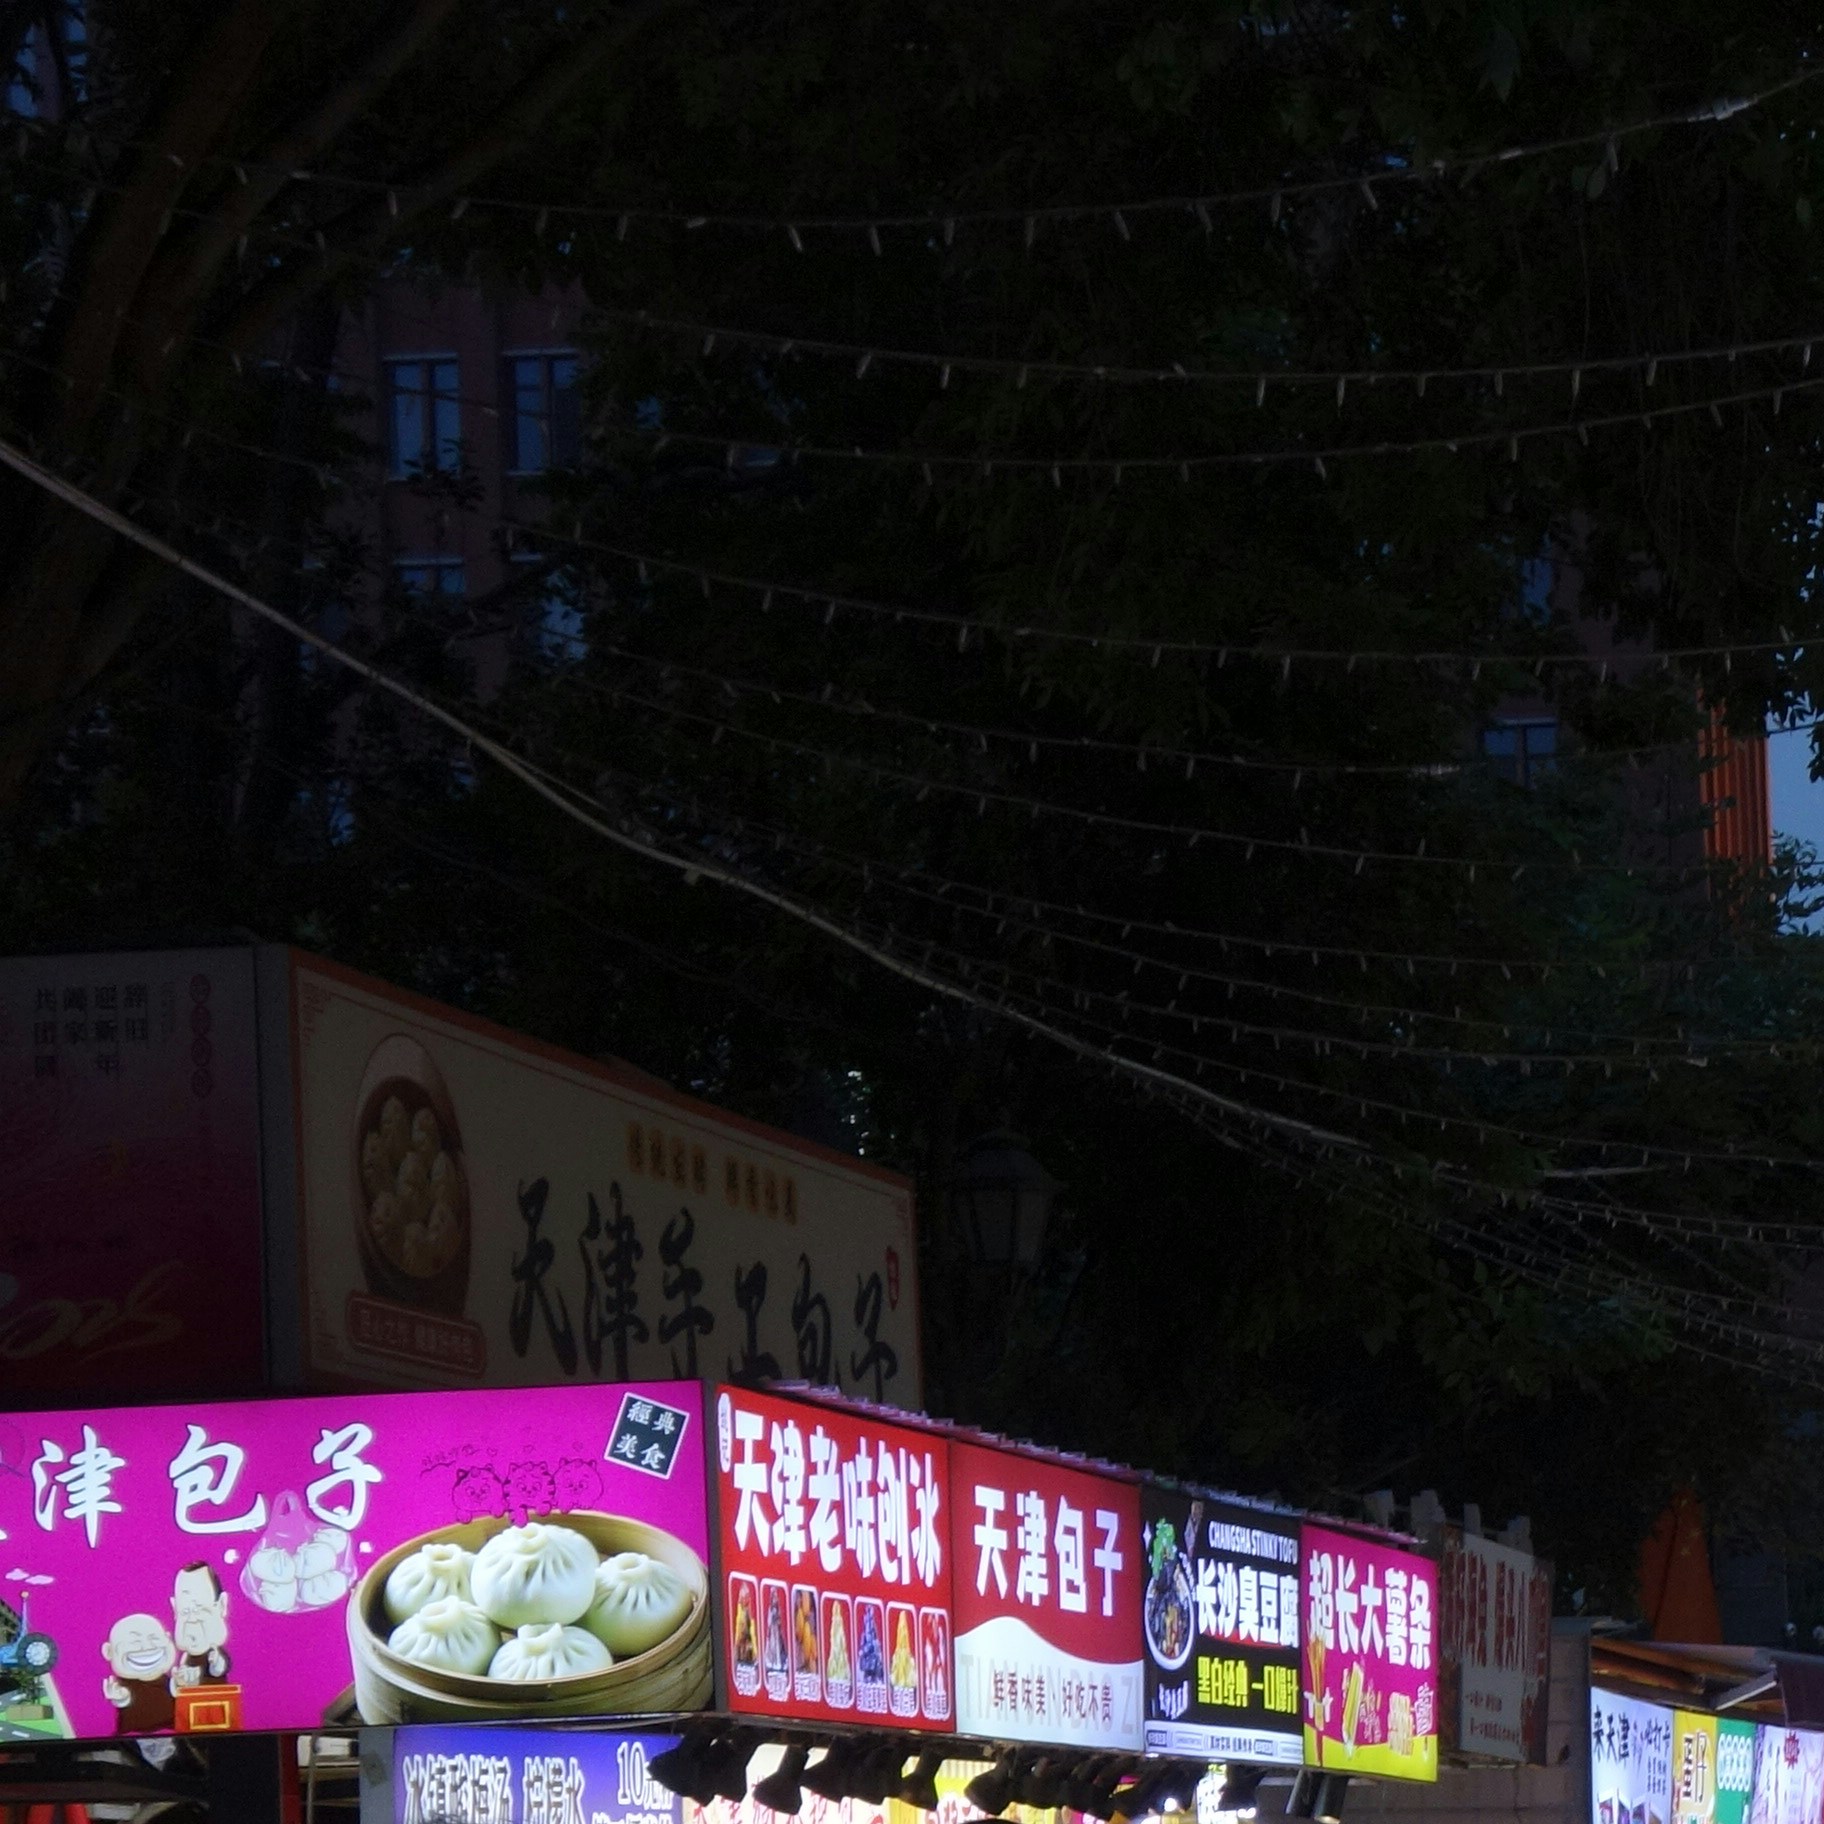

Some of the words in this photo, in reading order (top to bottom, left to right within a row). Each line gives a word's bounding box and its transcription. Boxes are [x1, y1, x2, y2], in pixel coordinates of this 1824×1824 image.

[613, 1432, 666, 1470] 美食
[627, 1401, 676, 1436] 經典
[0, 1423, 383, 1549] 津包子
[733, 1409, 942, 1588] 天津老味刨冰
[973, 1485, 1123, 1617] 天津包子
[1197, 1558, 1300, 1649] 长沙臭豆腐
[1308, 1549, 1432, 1670] 超长大薯条
[1062, 1677, 1113, 1721] 好吃不贵
